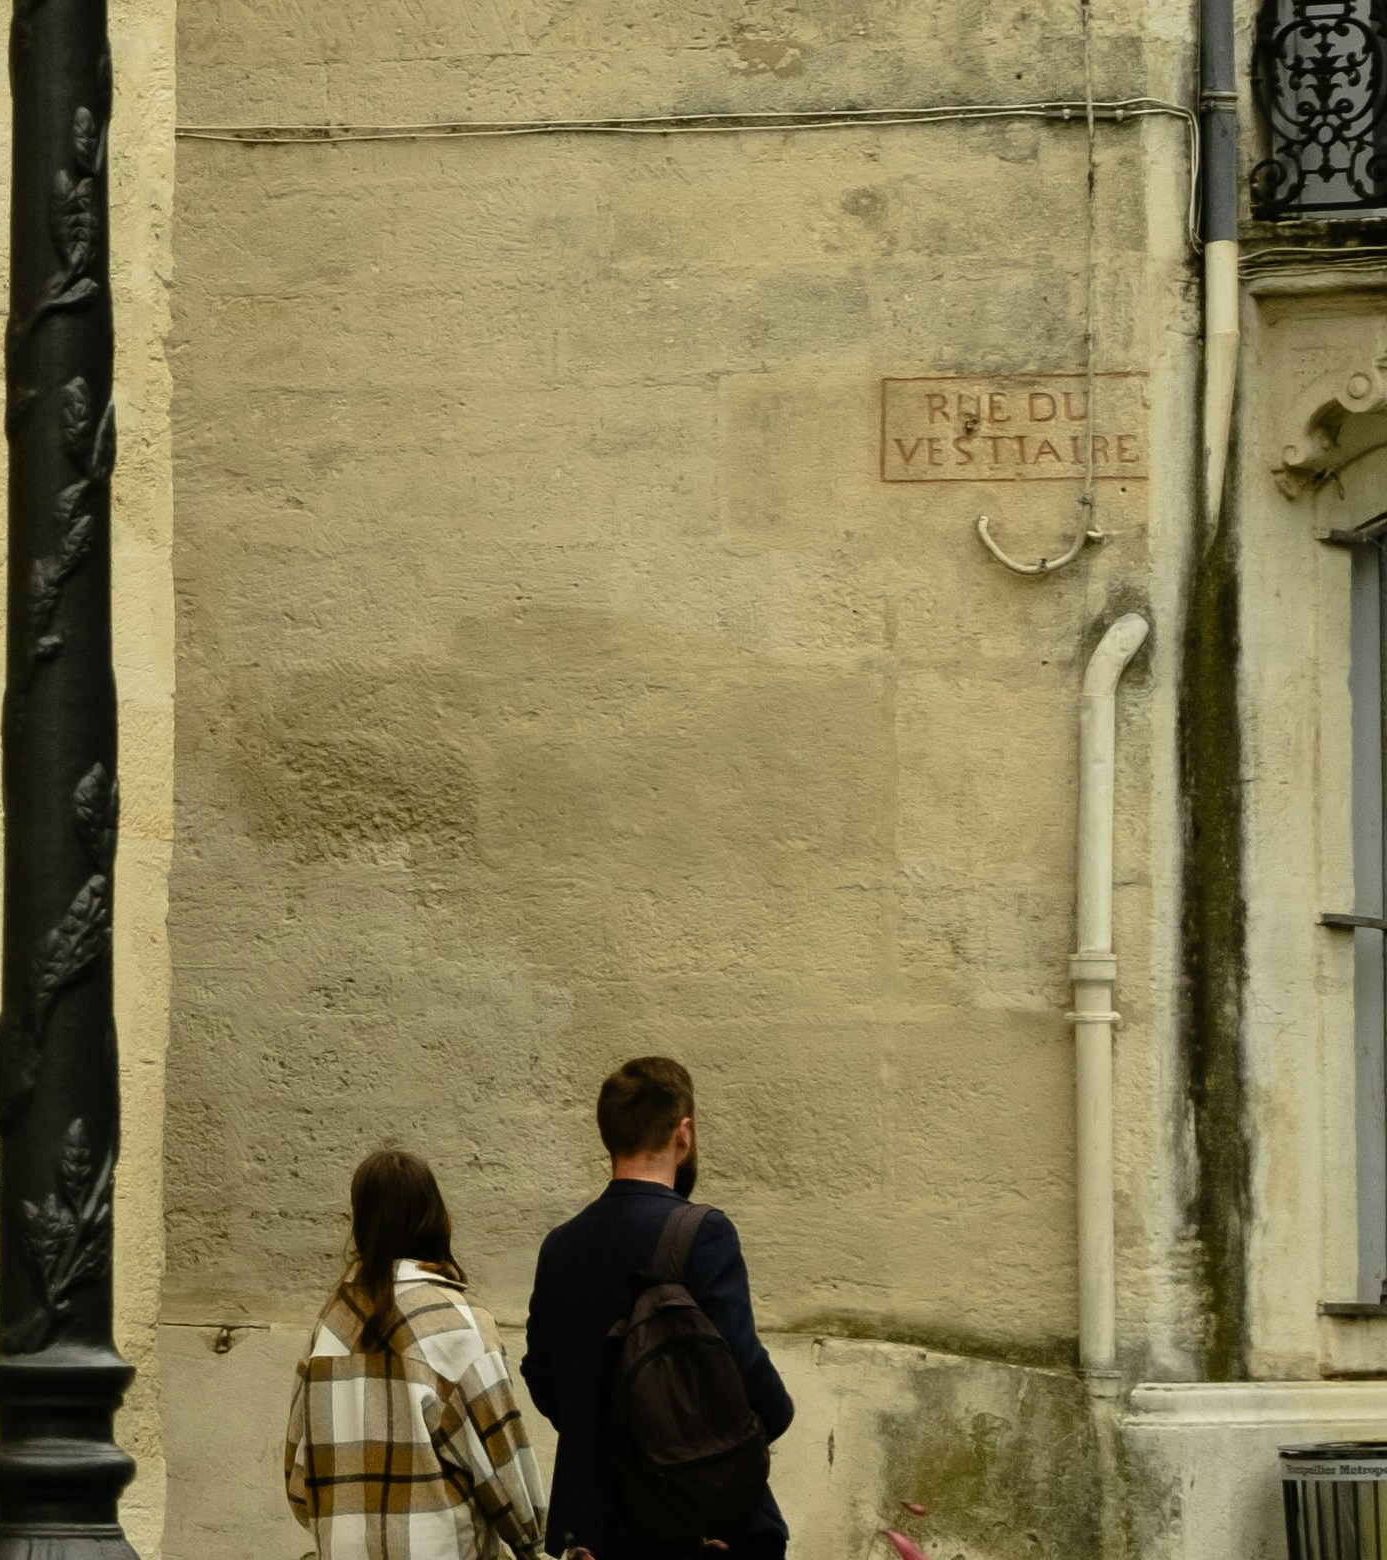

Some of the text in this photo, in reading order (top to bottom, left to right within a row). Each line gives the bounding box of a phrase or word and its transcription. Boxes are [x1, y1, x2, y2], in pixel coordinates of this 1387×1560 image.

[924, 391, 1090, 425] RUE DU
[894, 433, 1141, 467] VESTIAIRE
